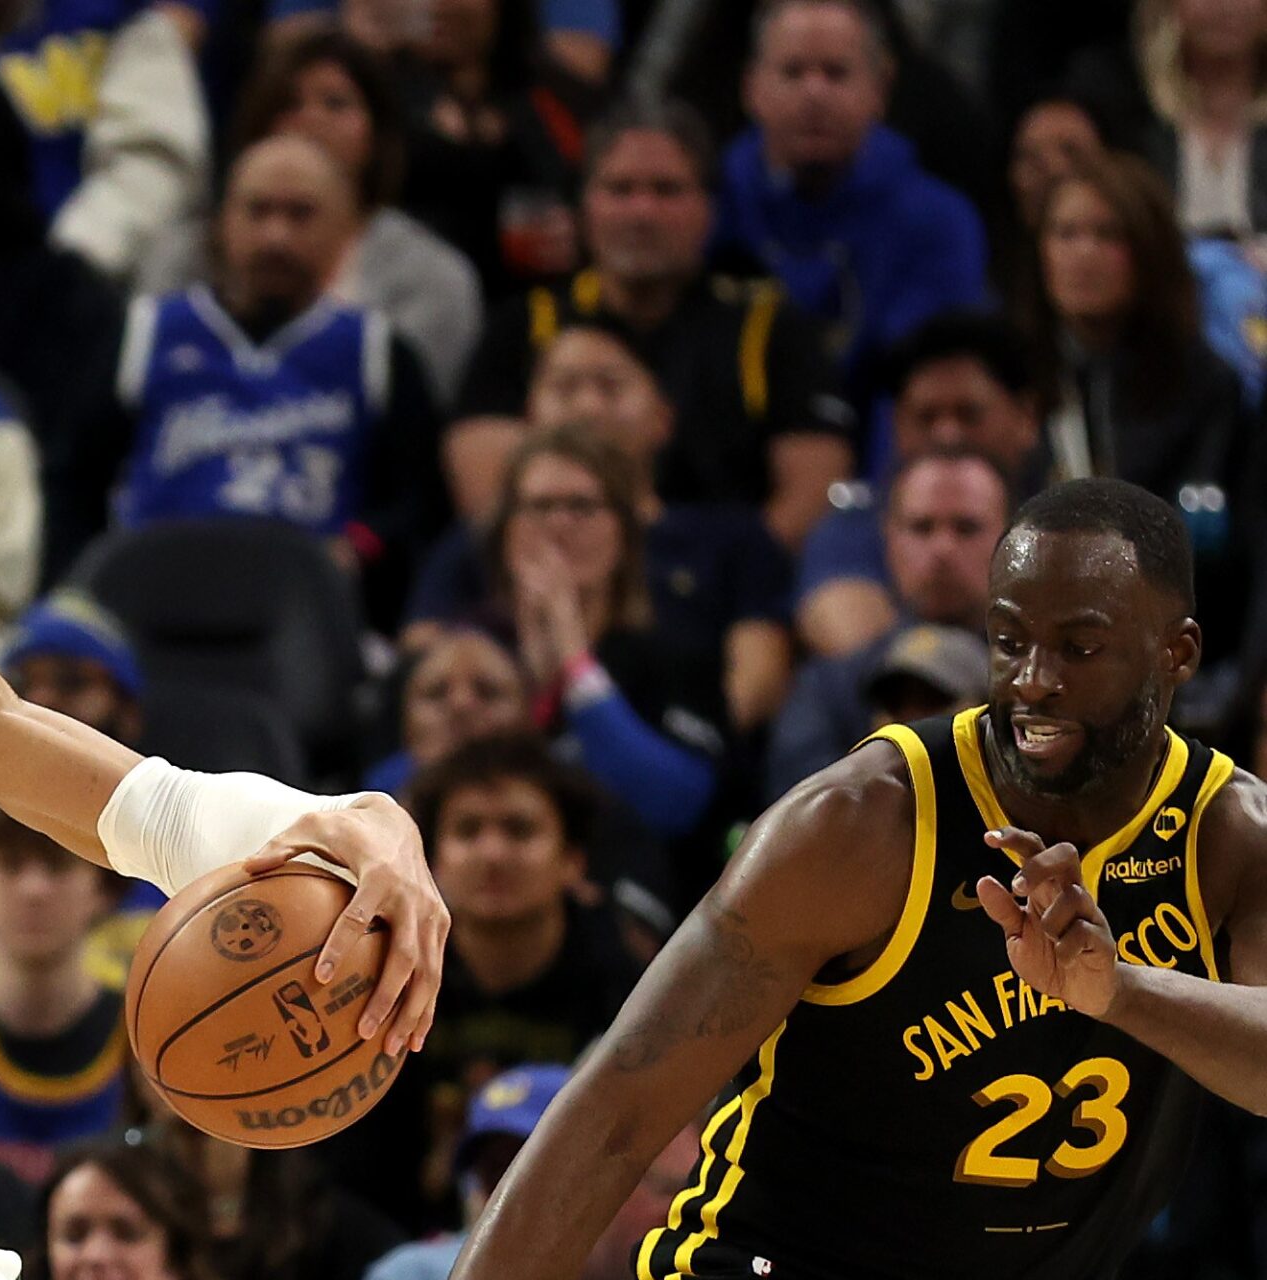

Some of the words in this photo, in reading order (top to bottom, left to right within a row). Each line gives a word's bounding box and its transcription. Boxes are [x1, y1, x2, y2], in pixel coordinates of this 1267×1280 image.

[1105, 856, 1182, 884] Rakuten
[902, 990, 997, 1081] SAN
[953, 1057, 1131, 1188] 23
